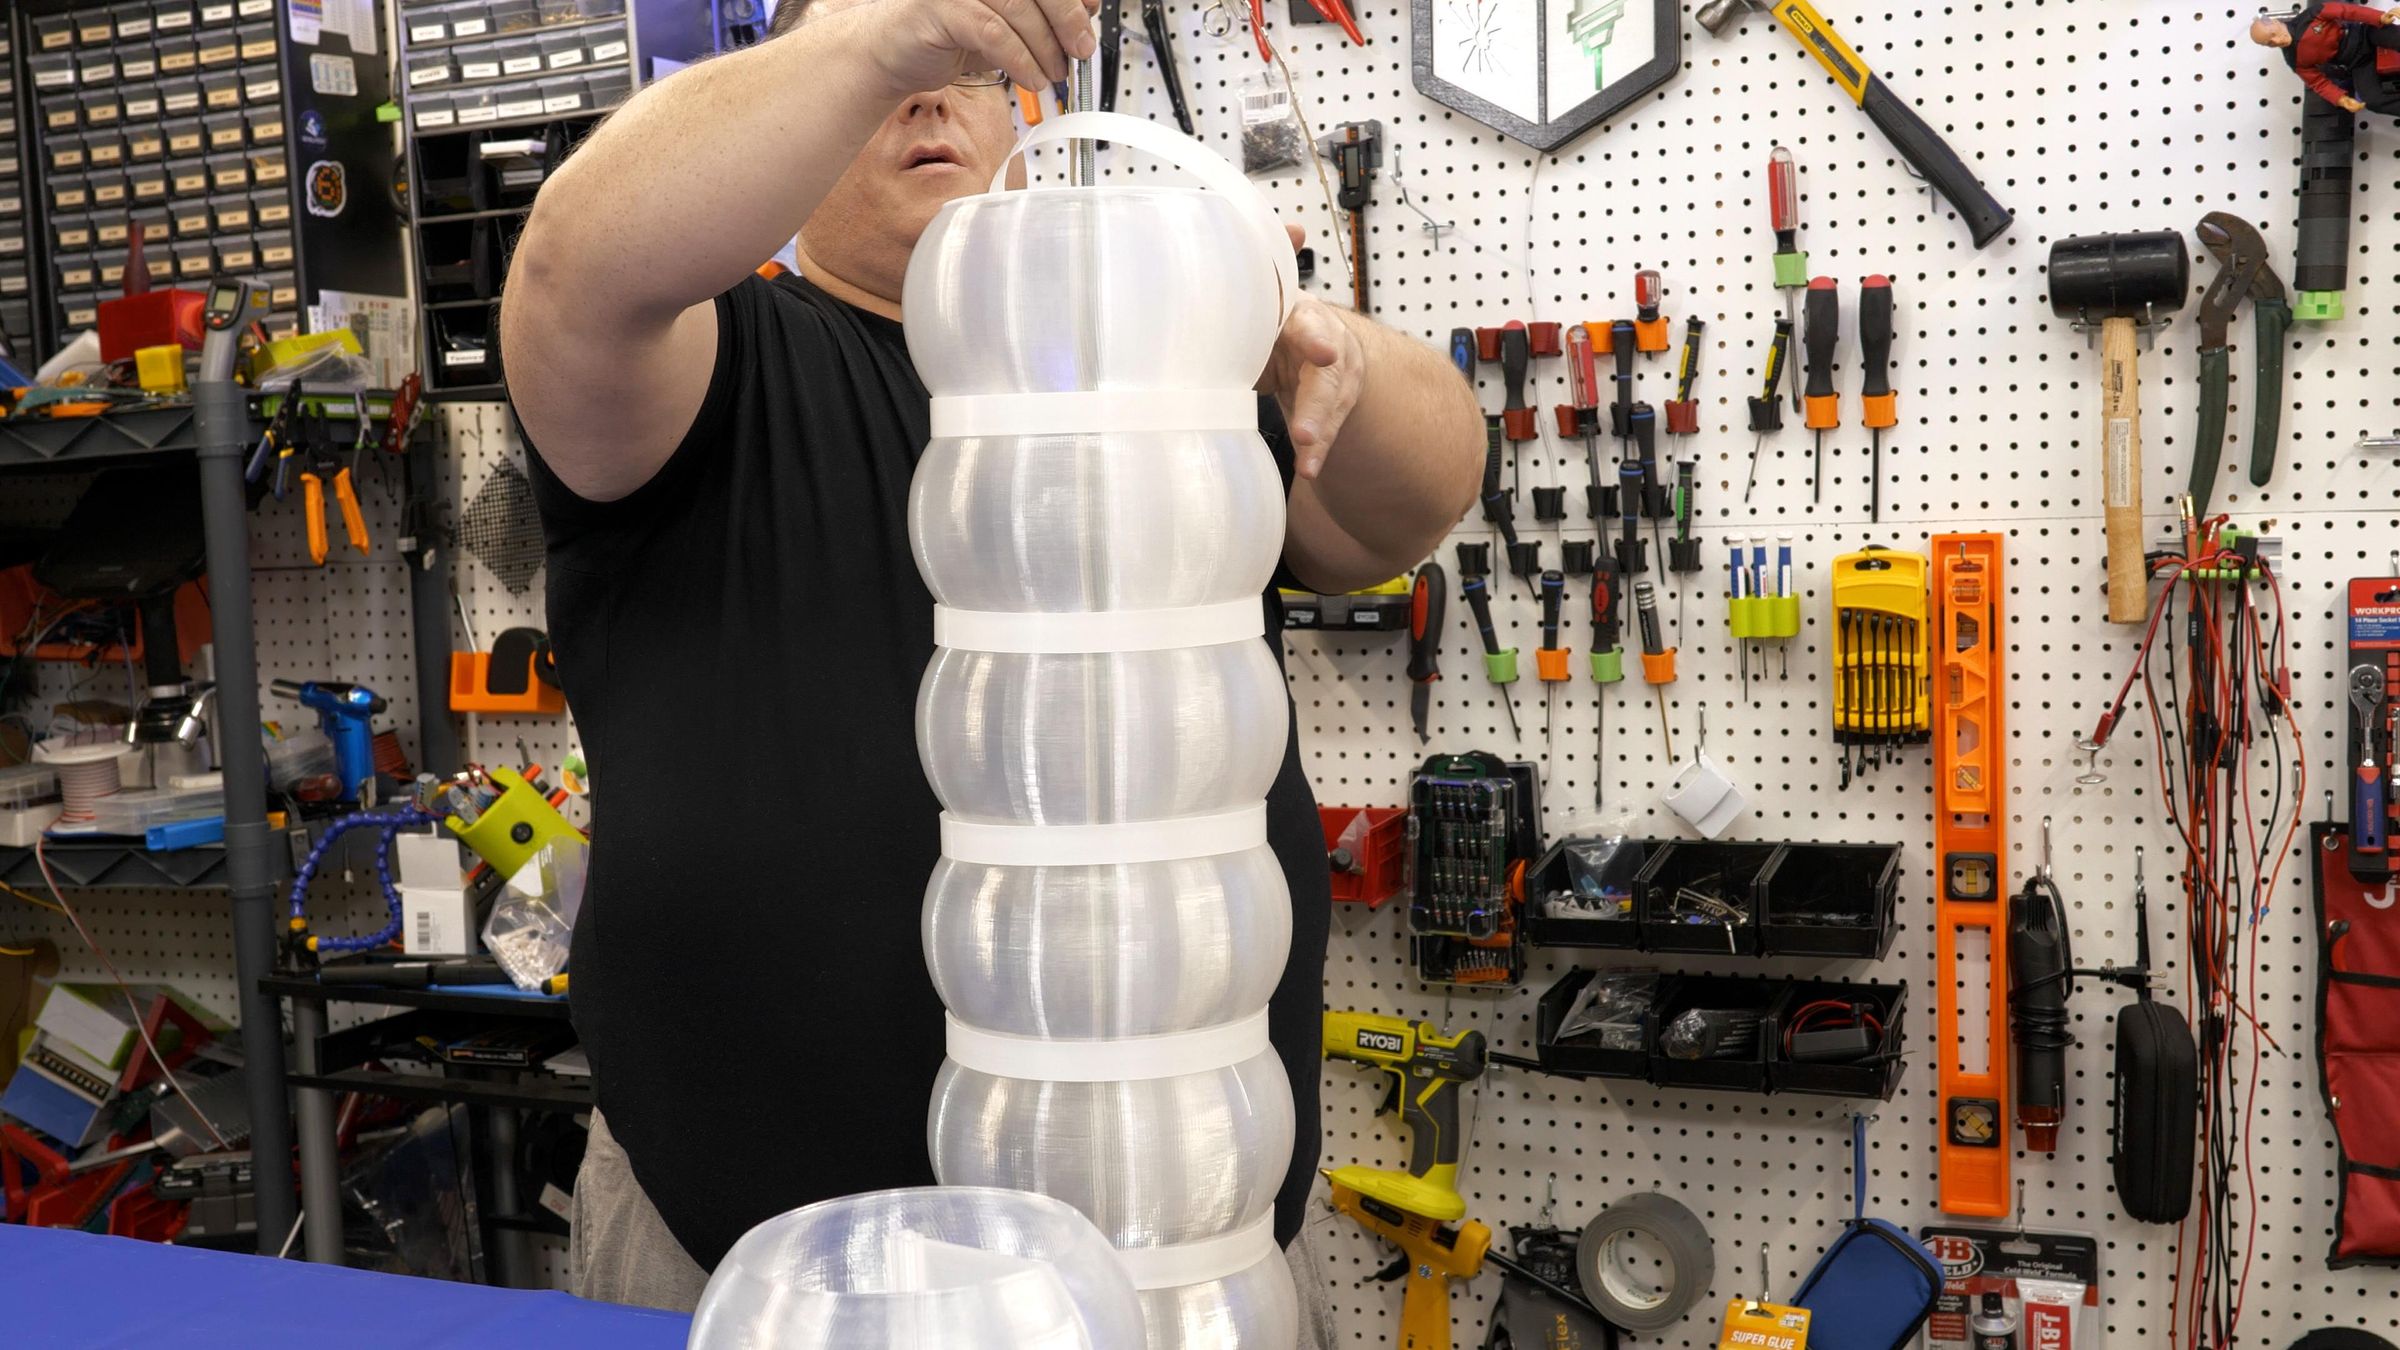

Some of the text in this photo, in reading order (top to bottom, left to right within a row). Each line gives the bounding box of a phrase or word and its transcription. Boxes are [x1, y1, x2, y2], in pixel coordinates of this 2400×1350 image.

[2355, 607, 2400, 615] WORKPRO
[1359, 1031, 1401, 1051] RYOBI
[1944, 1263, 1972, 1277] ELD
[2017, 1260, 2063, 1270] The Original
[1731, 1330, 1795, 1350] SUPER GLUE
